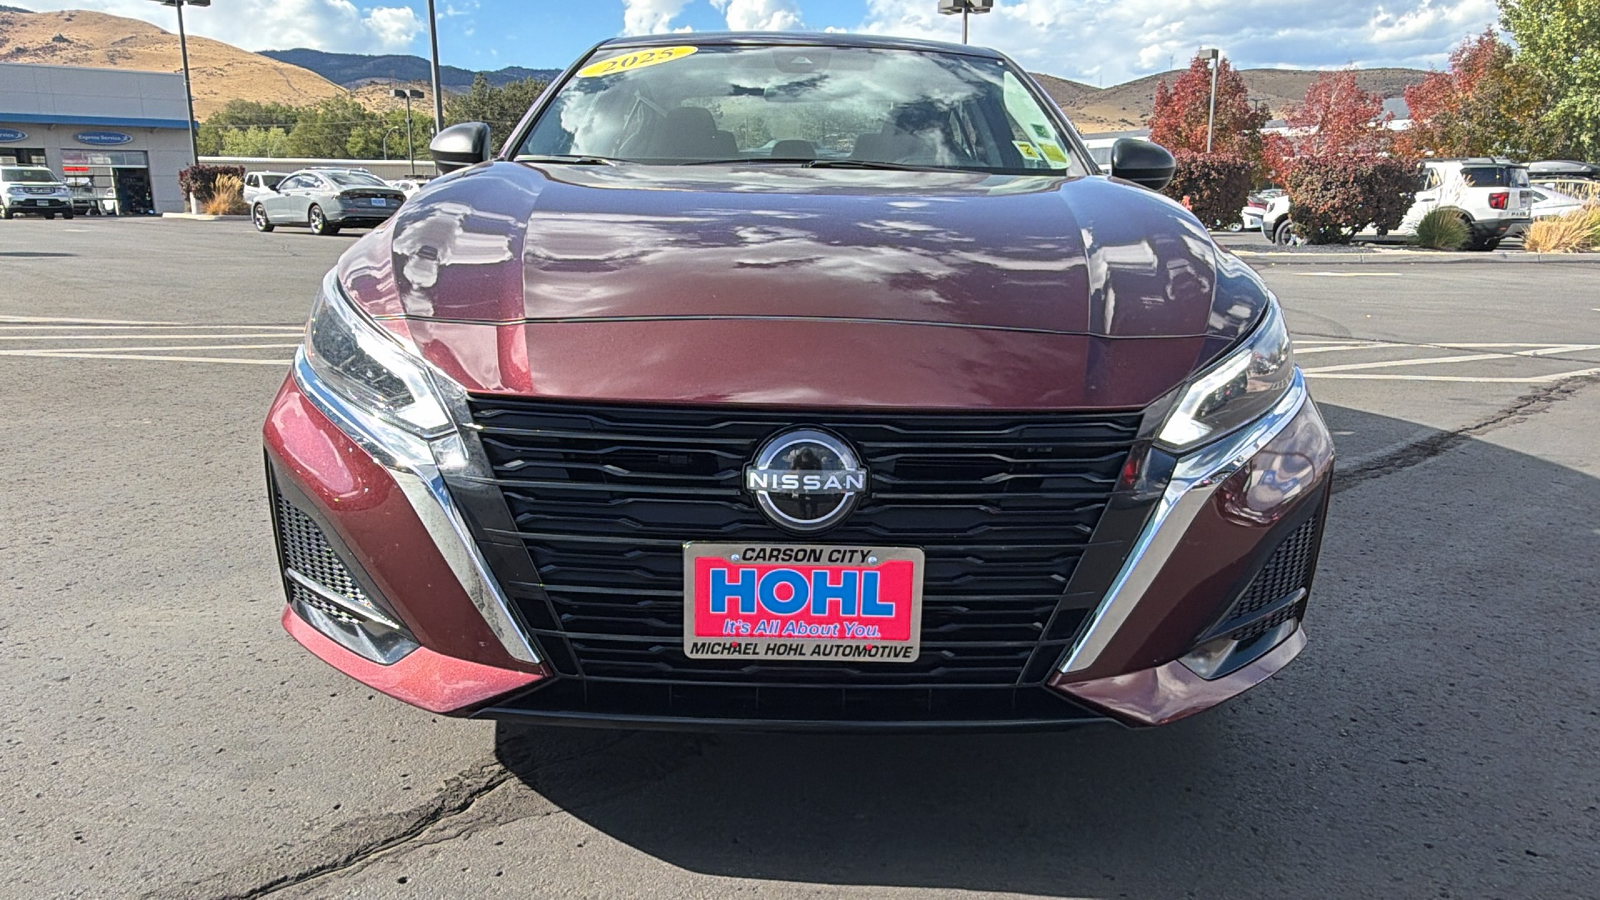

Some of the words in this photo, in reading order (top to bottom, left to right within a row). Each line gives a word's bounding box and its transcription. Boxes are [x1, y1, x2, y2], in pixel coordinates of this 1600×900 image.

[600, 48, 675, 73] 2025
[749, 472, 863, 490] NISSAN
[741, 547, 824, 563] CARSON
[827, 548, 872, 564] CITY
[709, 568, 896, 618] HOHL
[723, 619, 751, 635] It's
[754, 619, 780, 635] All
[783, 620, 839, 636] About
[842, 621, 881, 637] You.
[690, 642, 760, 656] MICHAEL
[764, 643, 806, 657] HOHL
[810, 644, 914, 658] AUTOMOTIVE
